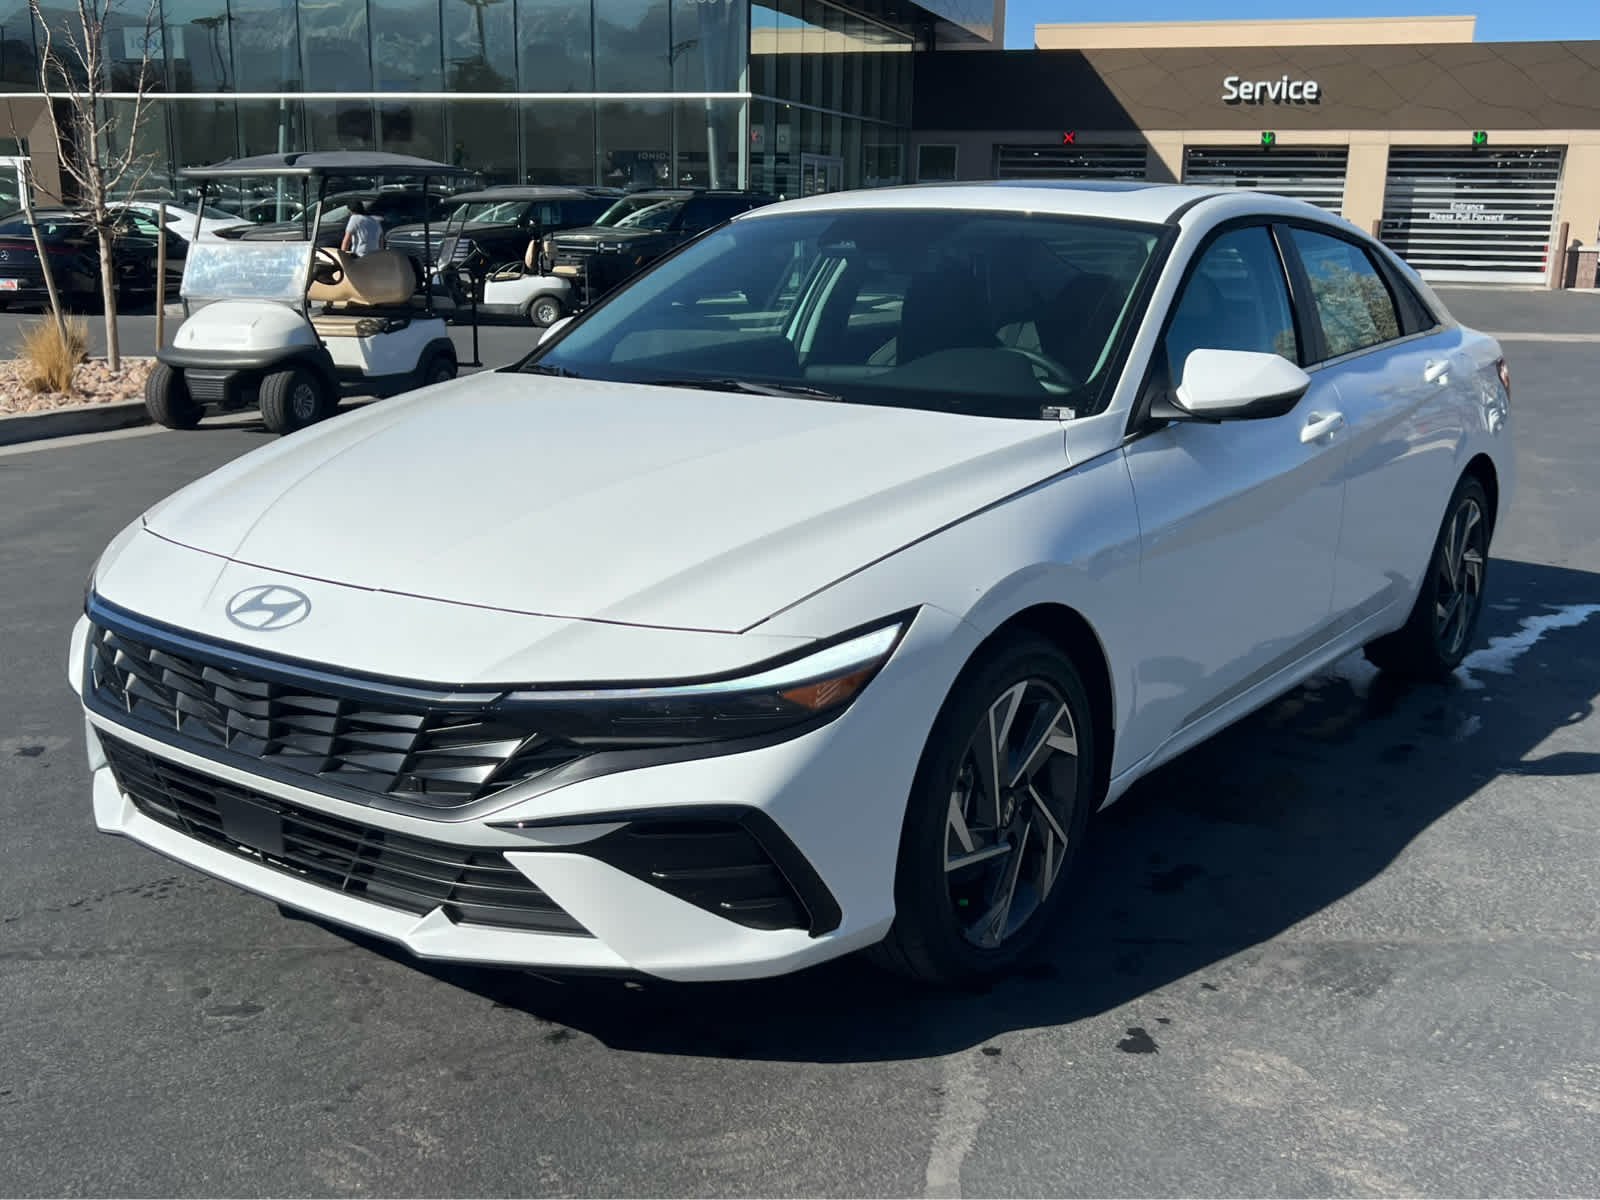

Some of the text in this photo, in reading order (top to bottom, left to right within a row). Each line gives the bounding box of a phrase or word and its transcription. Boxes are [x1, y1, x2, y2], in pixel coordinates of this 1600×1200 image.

[1221, 75, 1319, 101] Service
[1450, 201, 1485, 211] Entrance
[1429, 212, 1504, 222] Please Pull Forward
